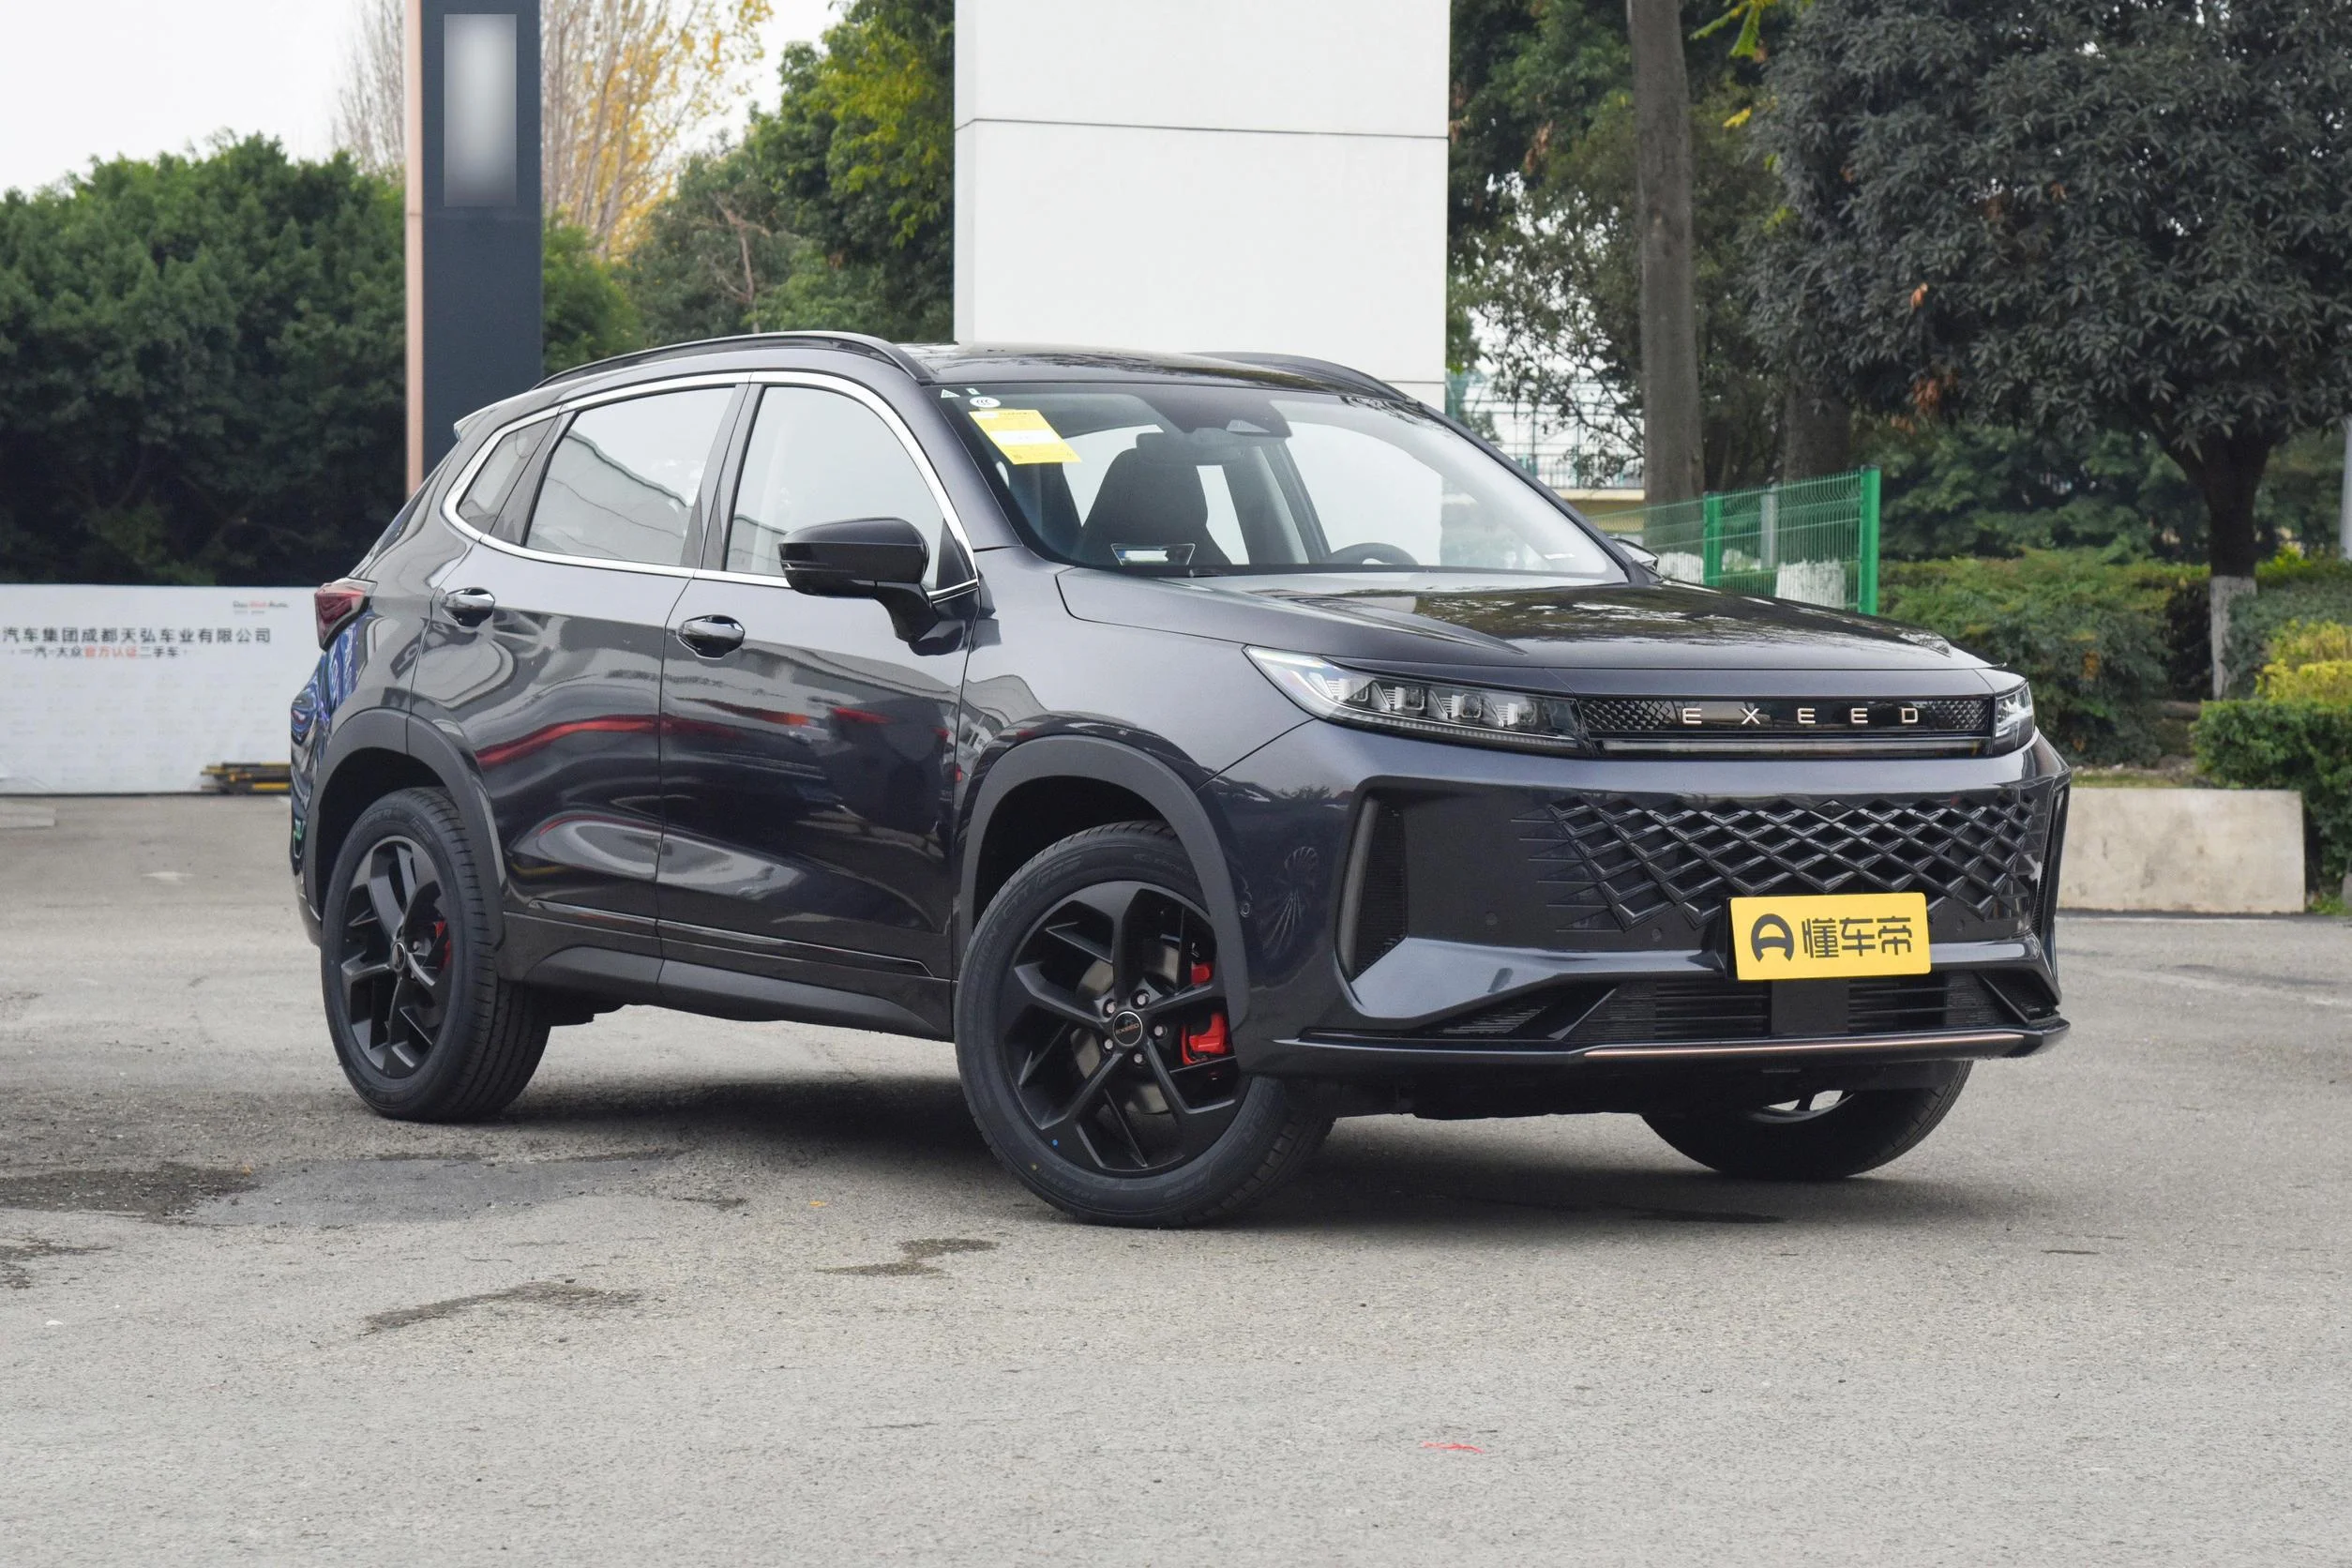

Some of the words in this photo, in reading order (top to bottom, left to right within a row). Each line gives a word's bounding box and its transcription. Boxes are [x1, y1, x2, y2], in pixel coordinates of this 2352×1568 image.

[1682, 707, 1919, 725] EXEED
[1802, 915, 1913, 958] 懂车帝
